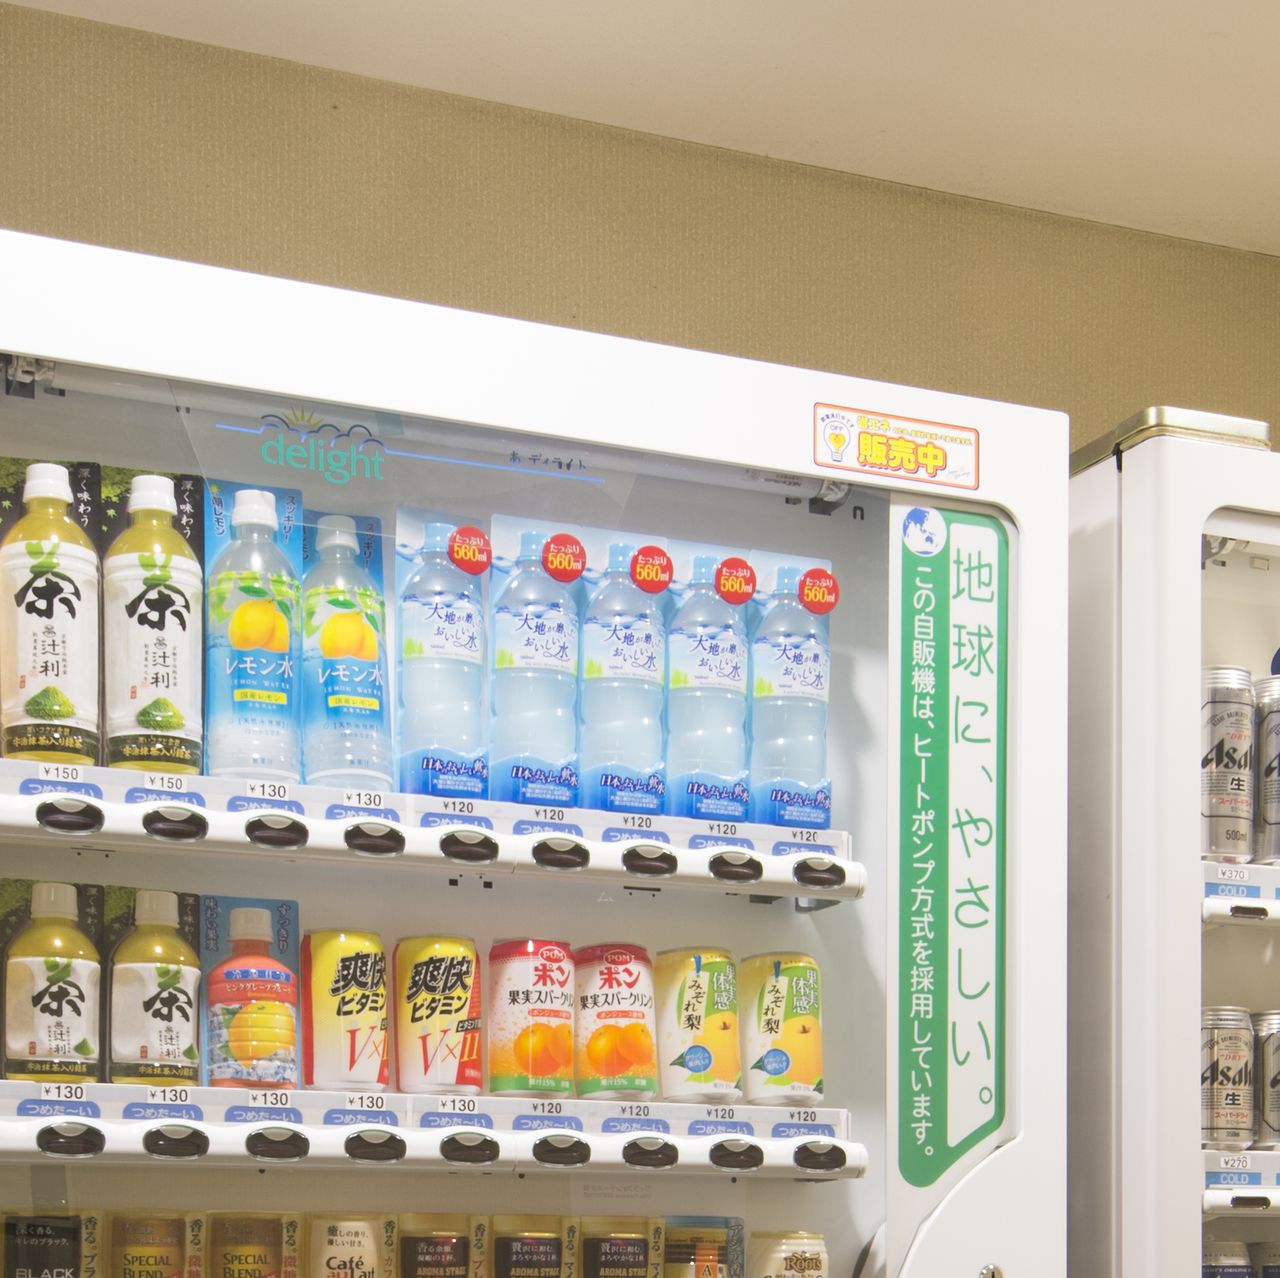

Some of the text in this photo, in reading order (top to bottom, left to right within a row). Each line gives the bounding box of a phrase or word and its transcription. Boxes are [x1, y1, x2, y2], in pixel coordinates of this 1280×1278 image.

[261, 434, 383, 484] delight
[858, 432, 946, 477] 販売中
[76, 466, 92, 528] 深く味わう
[179, 479, 195, 540] 深く味わう
[453, 544, 488, 562] 560ml
[549, 543, 580, 554] たっぷり
[547, 553, 582, 571] 560ml
[637, 555, 667, 566] たっぷり
[635, 565, 669, 582] 560ml
[722, 568, 751, 578] たっぷり
[720, 577, 753, 594] 560ml
[803, 586, 836, 603] 560ml
[224, 655, 294, 678] レモン水
[317, 663, 384, 686] レモン水
[1230, 776, 1246, 792] 生
[951, 548, 995, 1105] 地球に、やさしい。
[909, 566, 937, 1156] この自販機は、ヒートポンプ方式を採用しています。
[1218, 885, 1247, 898] COLD
[406, 955, 473, 1001] 爽快
[599, 966, 641, 990] ポン
[410, 996, 469, 1023] ビタミン
[1224, 1092, 1242, 1106] 生
[123, 1254, 172, 1267] SPECIAL
[222, 1253, 269, 1266] SPECIAL
[325, 1256, 365, 1271] Café
